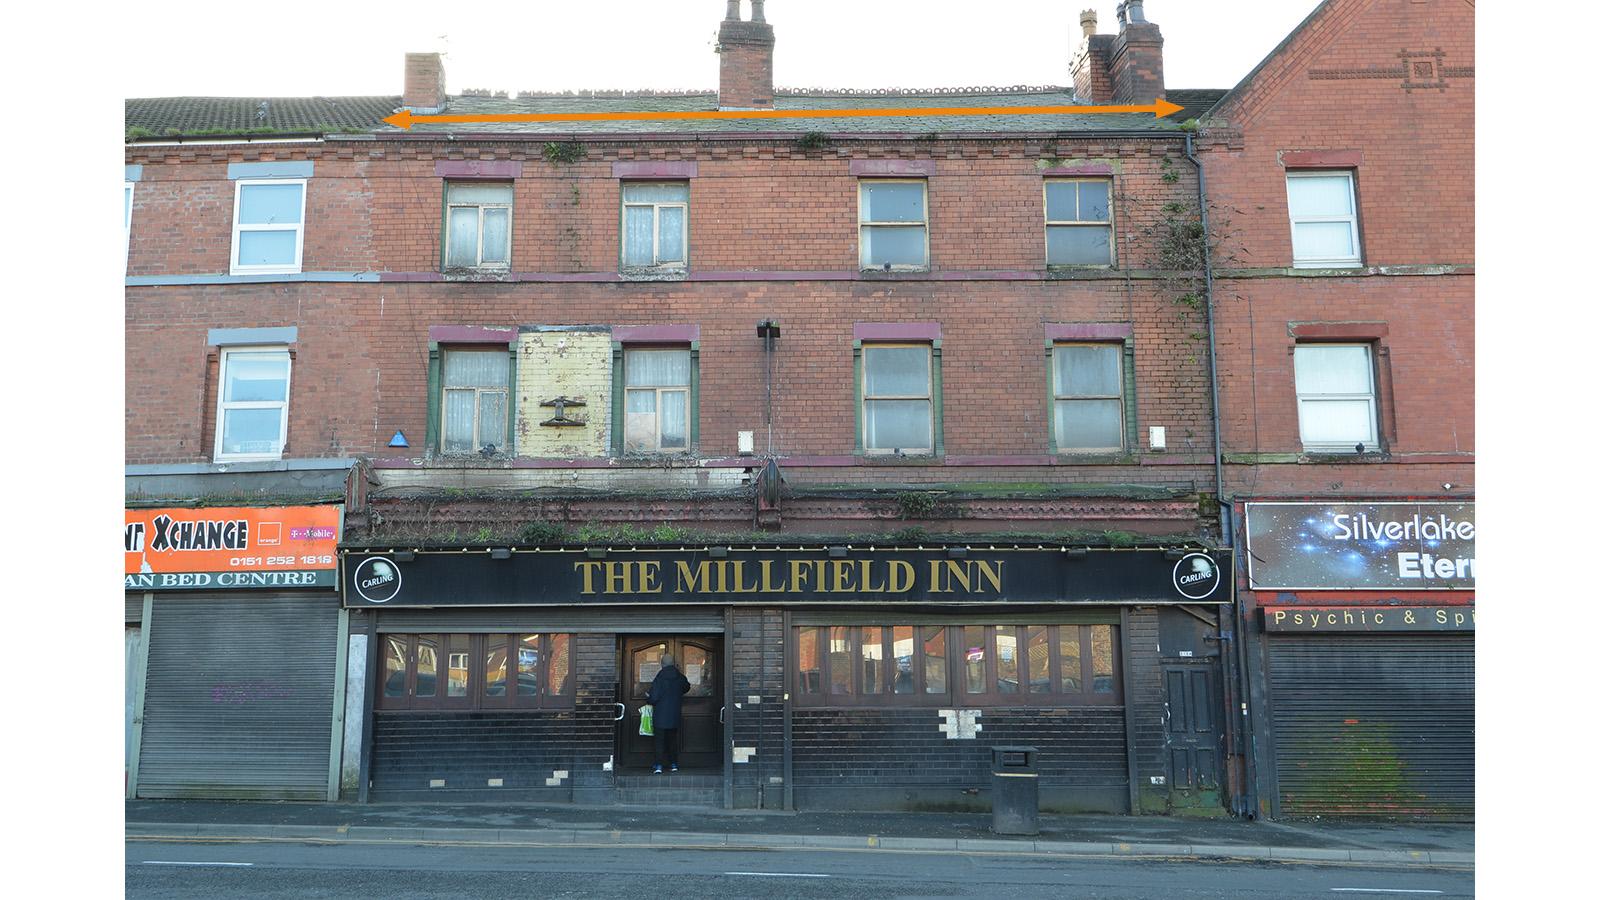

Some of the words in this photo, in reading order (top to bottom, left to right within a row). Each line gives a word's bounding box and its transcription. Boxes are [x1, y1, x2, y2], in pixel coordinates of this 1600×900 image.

[151, 514, 249, 552] XCHANGE
[1334, 515, 1475, 540] Silverlake
[230, 557, 262, 566] 0151
[266, 557, 295, 565] 252
[300, 555, 332, 564] 1818
[1398, 552, 1475, 578] Eter
[161, 573, 211, 586] BED
[217, 572, 316, 585] CENTRE
[362, 573, 393, 588] CARLING
[574, 560, 663, 594] THE
[674, 560, 915, 593] MILLFIELD
[927, 560, 1004, 593] INN
[1180, 570, 1212, 584] CARLING
[1274, 611, 1384, 627] Psychic
[1404, 610, 1416, 624] &
